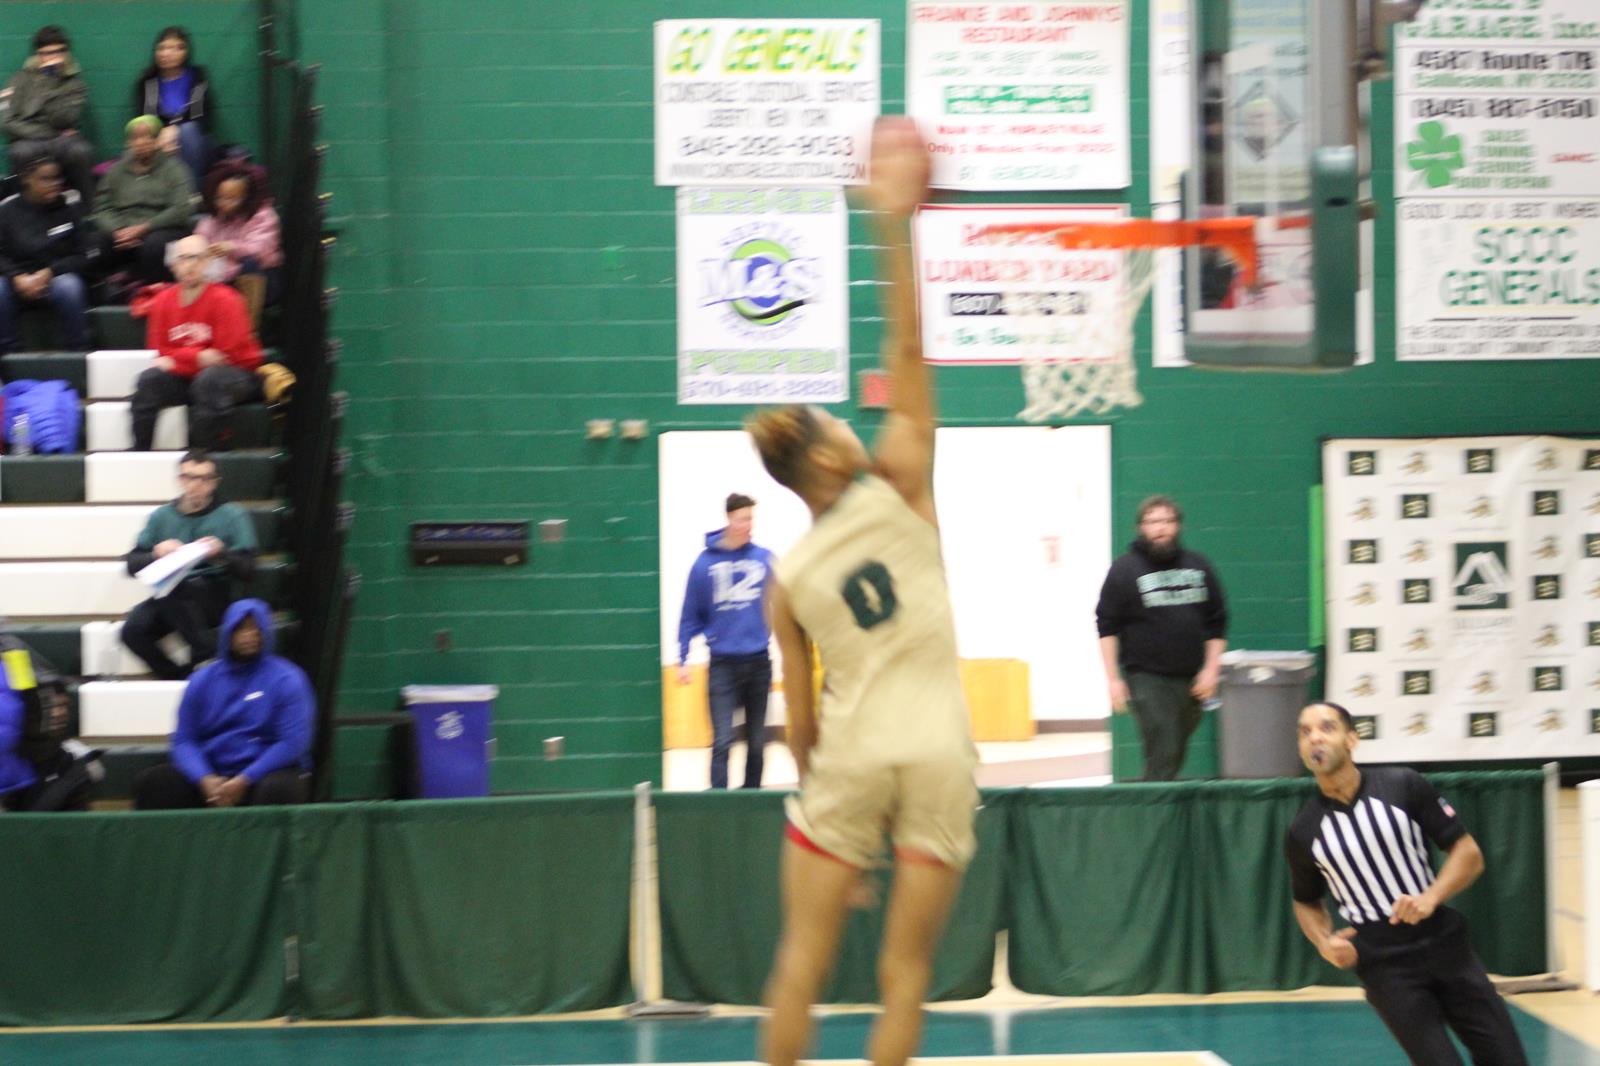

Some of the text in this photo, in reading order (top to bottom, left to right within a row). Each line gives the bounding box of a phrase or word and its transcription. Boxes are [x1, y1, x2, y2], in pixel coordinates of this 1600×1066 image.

[667, 26, 867, 73] GO GENERALS
[1479, 51, 1551, 70] Route
[1472, 226, 1577, 264] SCCC
[1440, 269, 1600, 306] GENERALS
[708, 560, 767, 604] 12
[841, 560, 899, 628] 0
